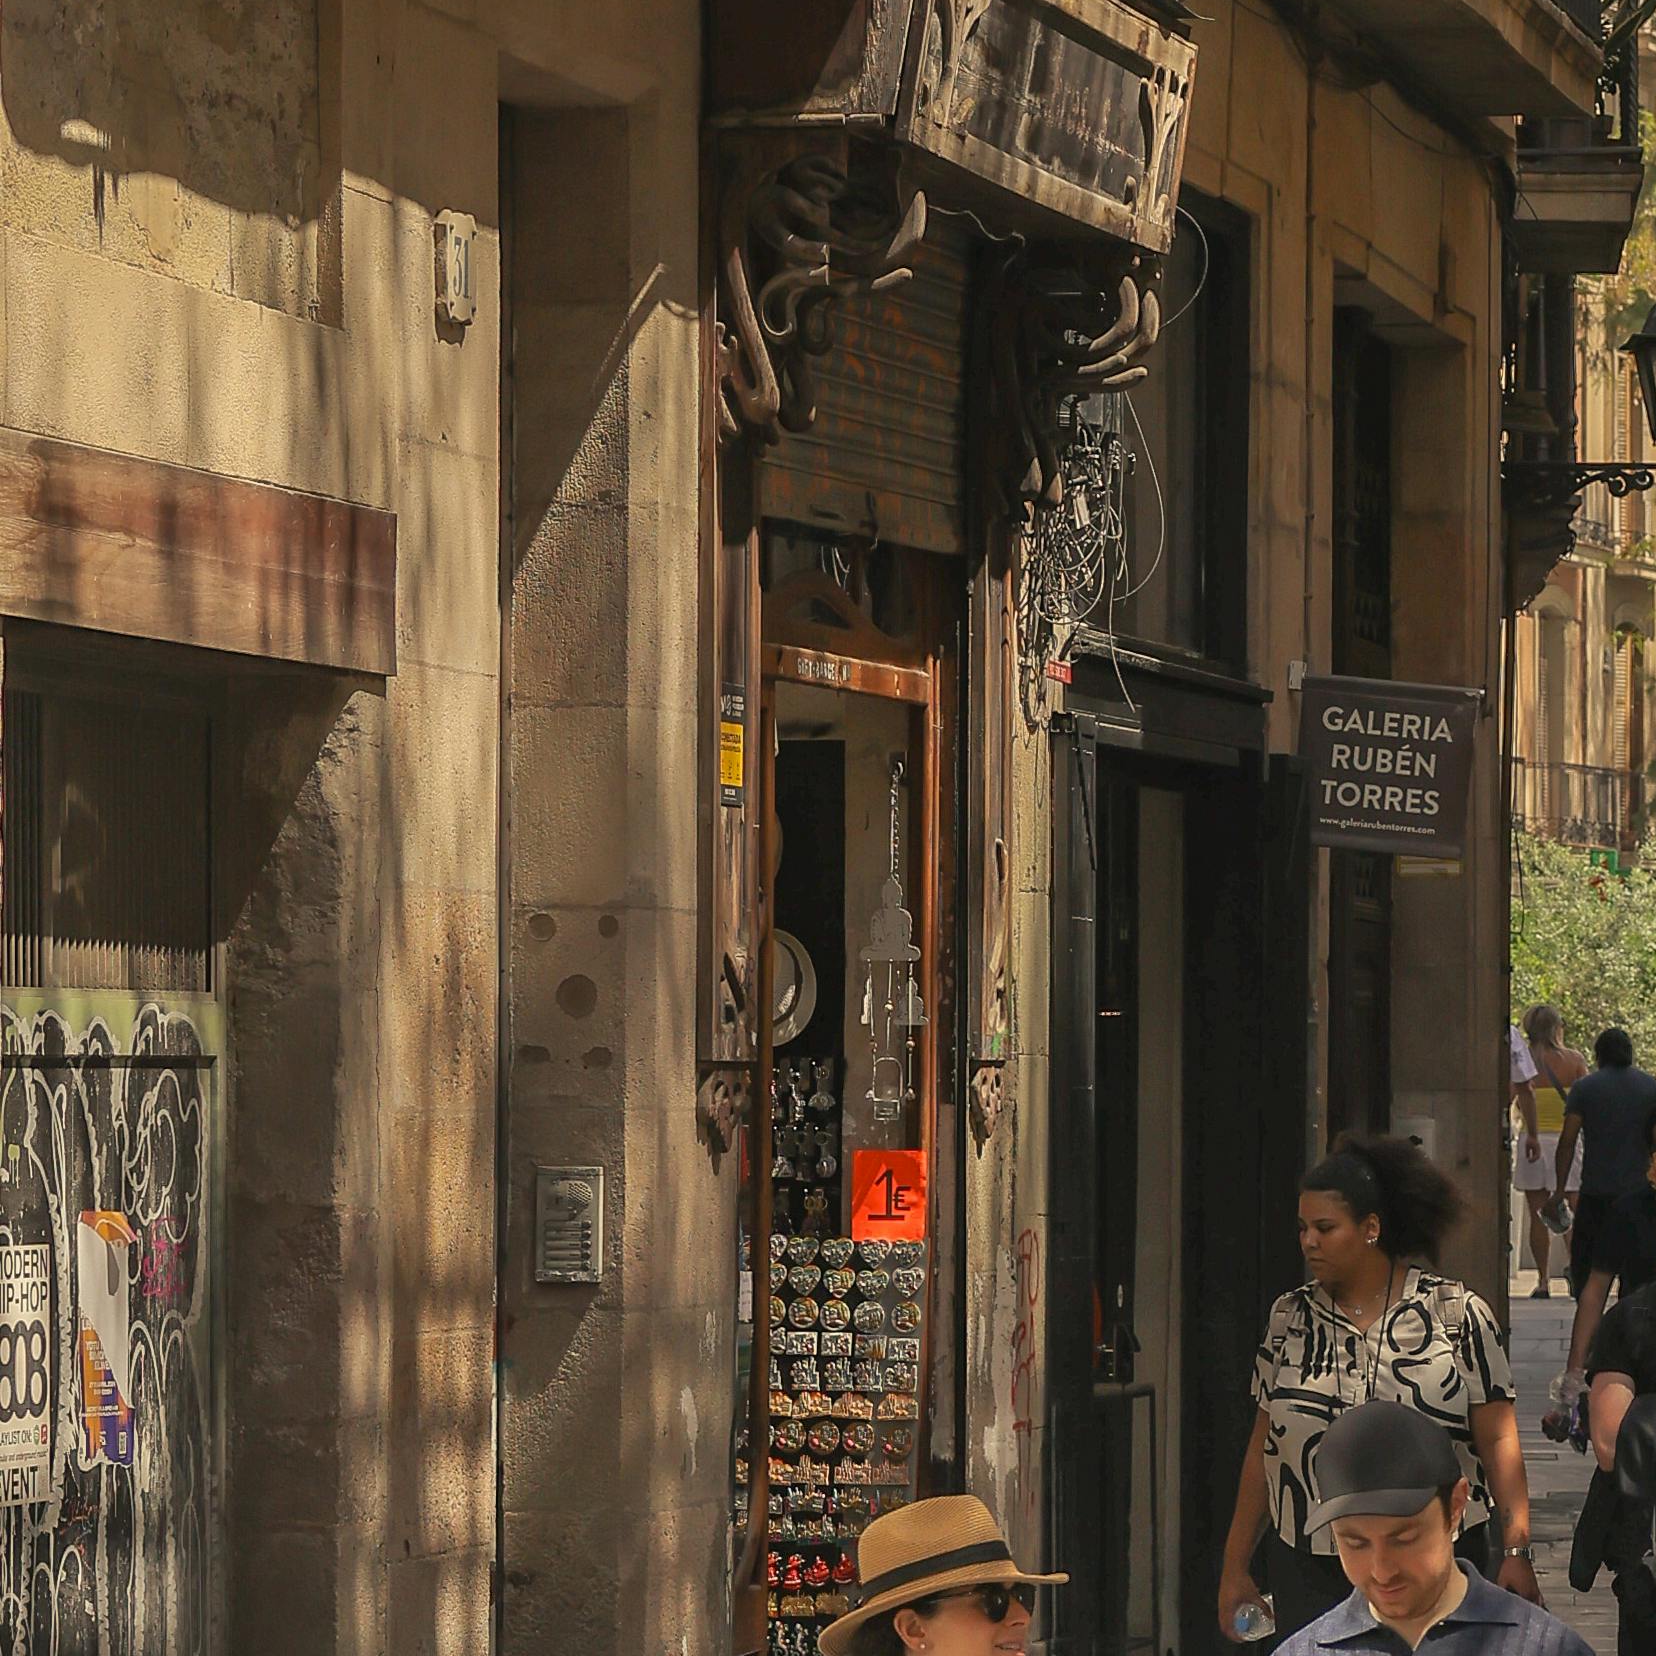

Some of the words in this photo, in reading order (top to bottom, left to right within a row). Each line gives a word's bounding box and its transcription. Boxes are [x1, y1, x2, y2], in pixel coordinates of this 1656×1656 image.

[453, 235, 469, 299] 31
[1322, 706, 1453, 743] GALERIA
[1331, 744, 1437, 778] RUBÉN
[1320, 780, 1440, 816] TORRES
[1319, 817, 1436, 835] www.galeriarubentorres.com
[867, 1169, 912, 1221] 1€
[0, 1248, 48, 1281] ODERN
[0, 1281, 48, 1314] IP-HOP
